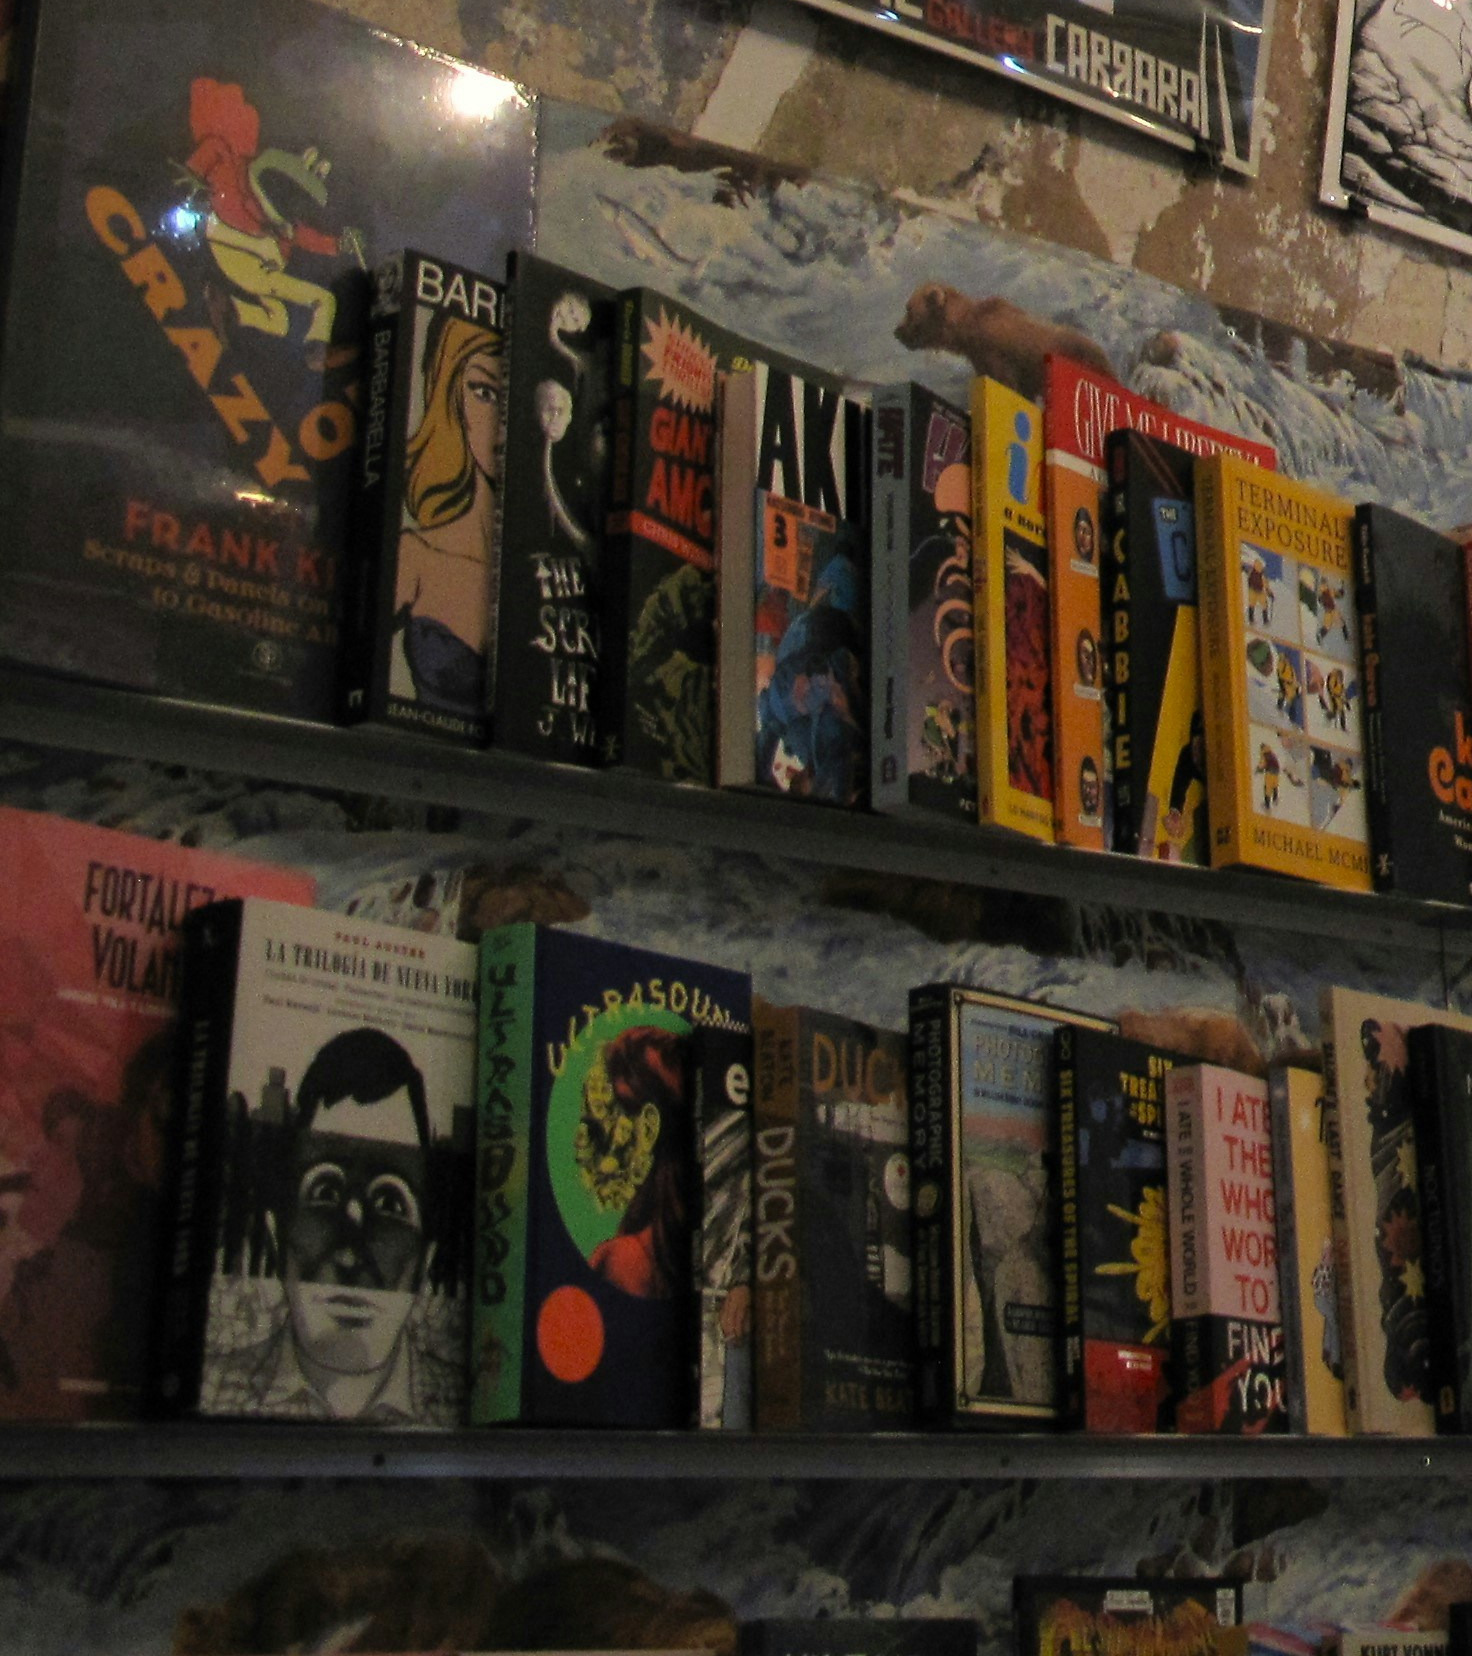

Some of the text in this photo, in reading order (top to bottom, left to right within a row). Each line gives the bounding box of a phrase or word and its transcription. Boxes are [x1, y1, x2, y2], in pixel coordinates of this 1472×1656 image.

[85, 184, 313, 489] CRAZY
[364, 328, 394, 489] BARBARELLA
[123, 500, 288, 576] FRANK
[1235, 477, 1347, 540] TERMINAL
[1237, 506, 1349, 570] EXPOSURE
[529, 551, 586, 600] THE
[1110, 527, 1132, 771] CABBIE
[1253, 826, 1324, 861] MICHAEL
[265, 937, 286, 963] LA
[371, 958, 389, 982] DE
[397, 966, 439, 995] NUEVA
[911, 1017, 927, 1173] MEMORY
[927, 1017, 946, 1170] PHOTOGRAPHIC
[1216, 1087, 1224, 1123] I
[1060, 1101, 1077, 1199] TREASURES
[1223, 1135, 1272, 1179] THE
[756, 1125, 798, 1283] DUCKS
[1179, 1159, 1197, 1296] WHOLE WORLD
